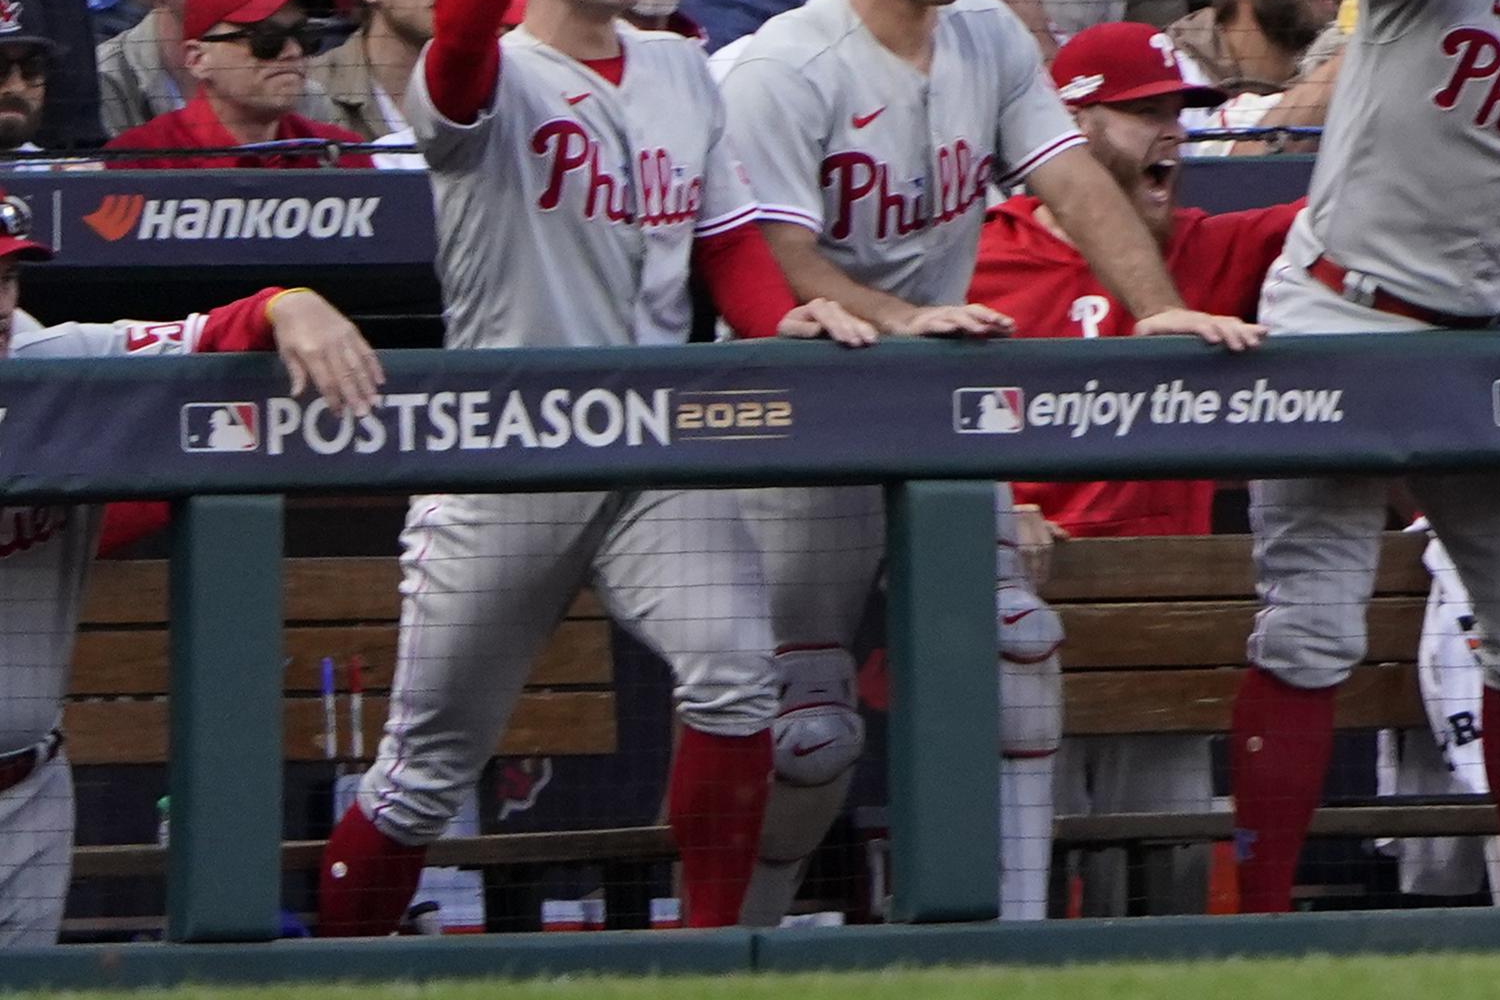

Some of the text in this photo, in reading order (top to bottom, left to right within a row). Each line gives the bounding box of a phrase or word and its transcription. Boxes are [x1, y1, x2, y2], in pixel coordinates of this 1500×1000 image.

[266, 388, 793, 456] POSTSEASON 2022
[1027, 378, 1345, 438] enjoy the show.
